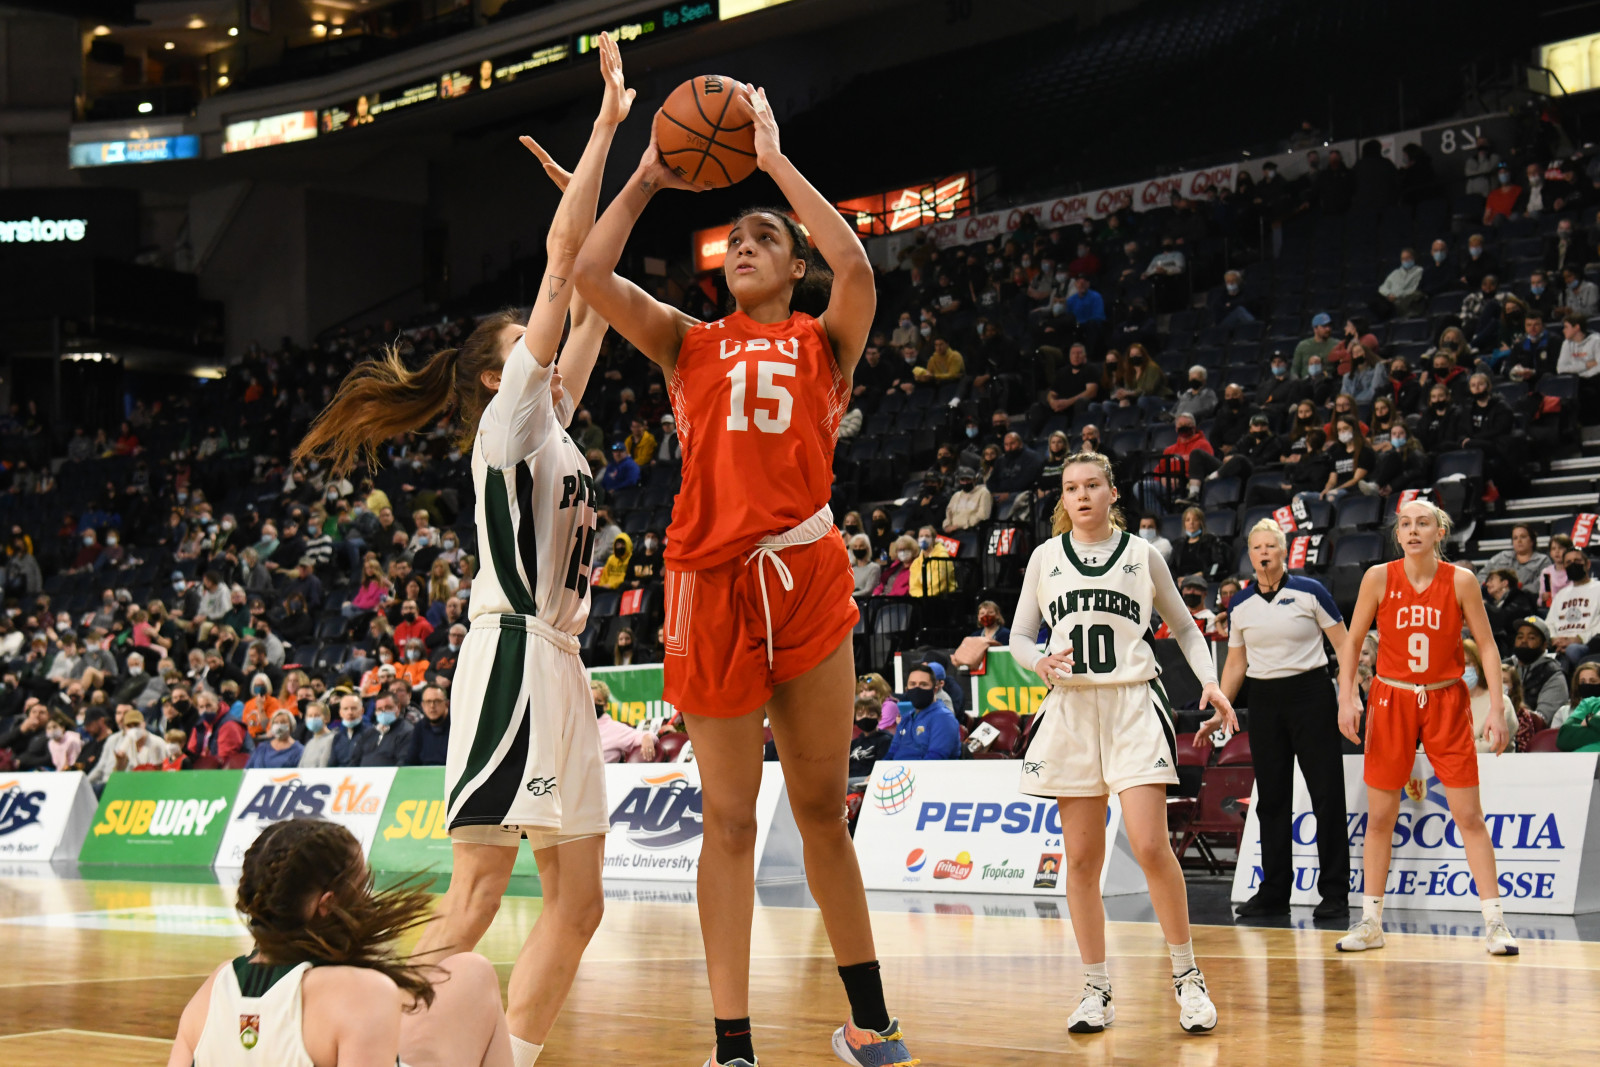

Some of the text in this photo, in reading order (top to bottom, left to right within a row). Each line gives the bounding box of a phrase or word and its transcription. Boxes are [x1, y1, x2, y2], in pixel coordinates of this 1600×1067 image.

[663, 11, 679, 27] Be
[726, 360, 796, 435] 15
[1048, 588, 1141, 627] PANTHERS
[1396, 605, 1442, 631] CBU
[1562, 598, 1590, 610] ROOTS
[1069, 624, 1117, 675] 10
[1407, 633, 1430, 673] 9
[94, 797, 228, 837] SUBWAY
[236, 783, 332, 820] AUS
[383, 799, 448, 841] SUB
[915, 801, 1112, 835] PEPSIC
[603, 853, 693, 873] antic University
[981, 862, 1025, 881] Tropicana
